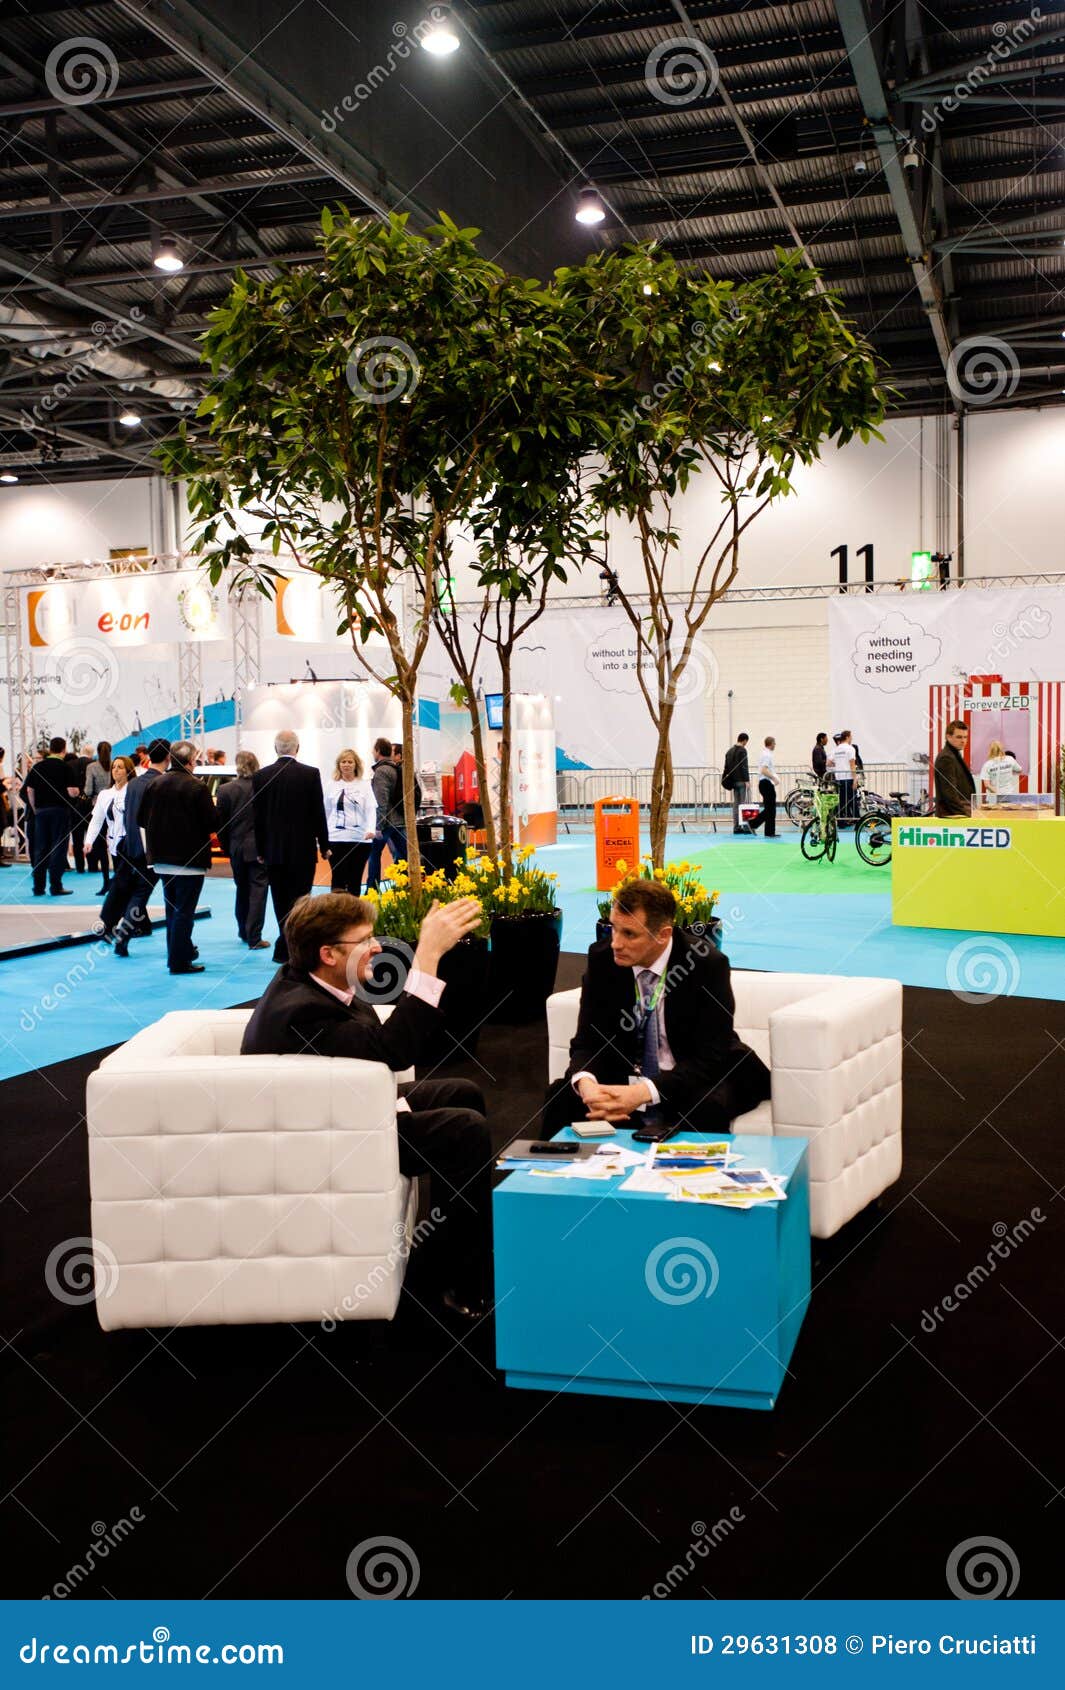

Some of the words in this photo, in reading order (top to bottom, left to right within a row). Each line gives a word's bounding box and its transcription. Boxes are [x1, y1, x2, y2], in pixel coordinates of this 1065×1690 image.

[830, 544, 874, 593] 11
[869, 636, 911, 647] without
[592, 649, 625, 658] without
[867, 650, 913, 661] needing
[602, 662, 619, 670] into
[875, 664, 916, 673] shower
[898, 827, 1010, 848] HiminZED
